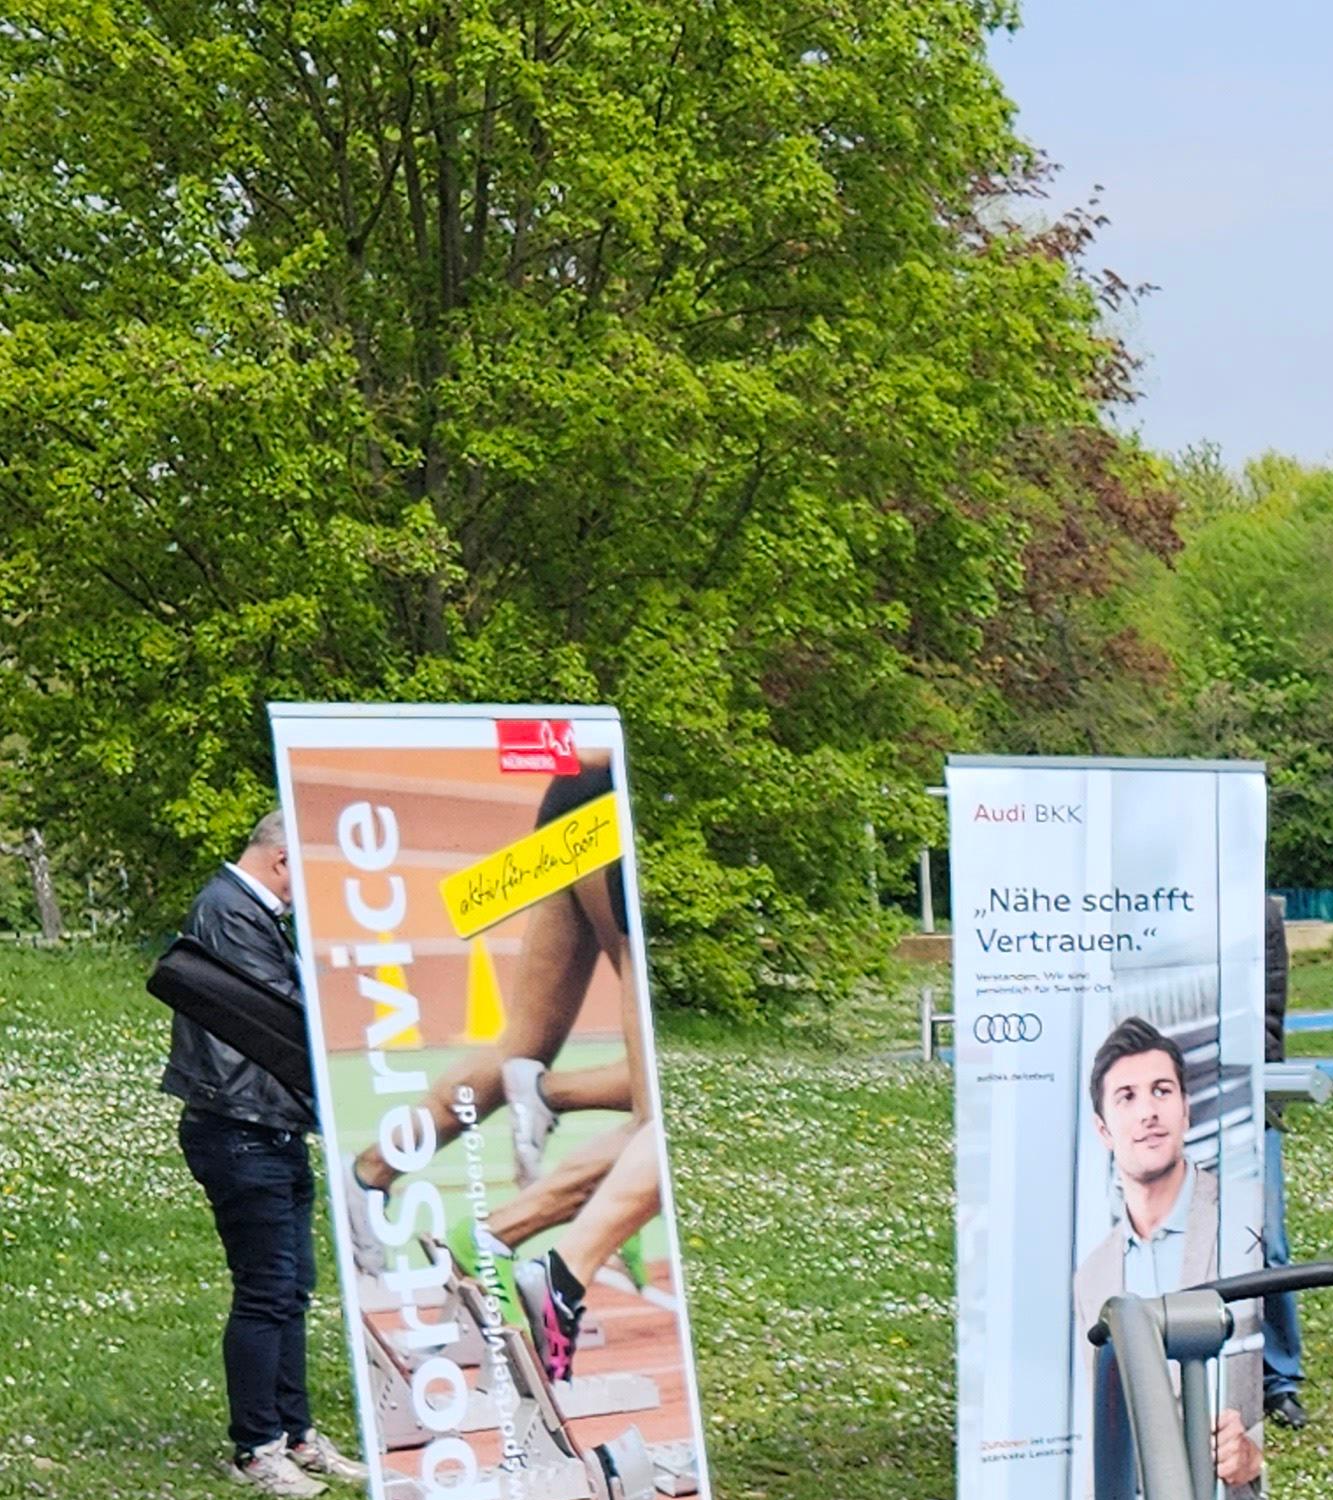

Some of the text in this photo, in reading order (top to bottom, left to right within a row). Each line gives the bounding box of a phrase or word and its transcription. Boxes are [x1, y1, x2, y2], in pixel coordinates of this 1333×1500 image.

[973, 803, 1084, 823] Audi BKK
[560, 816, 611, 876] Sport
[974, 887, 1195, 919] „Nähe schafft
